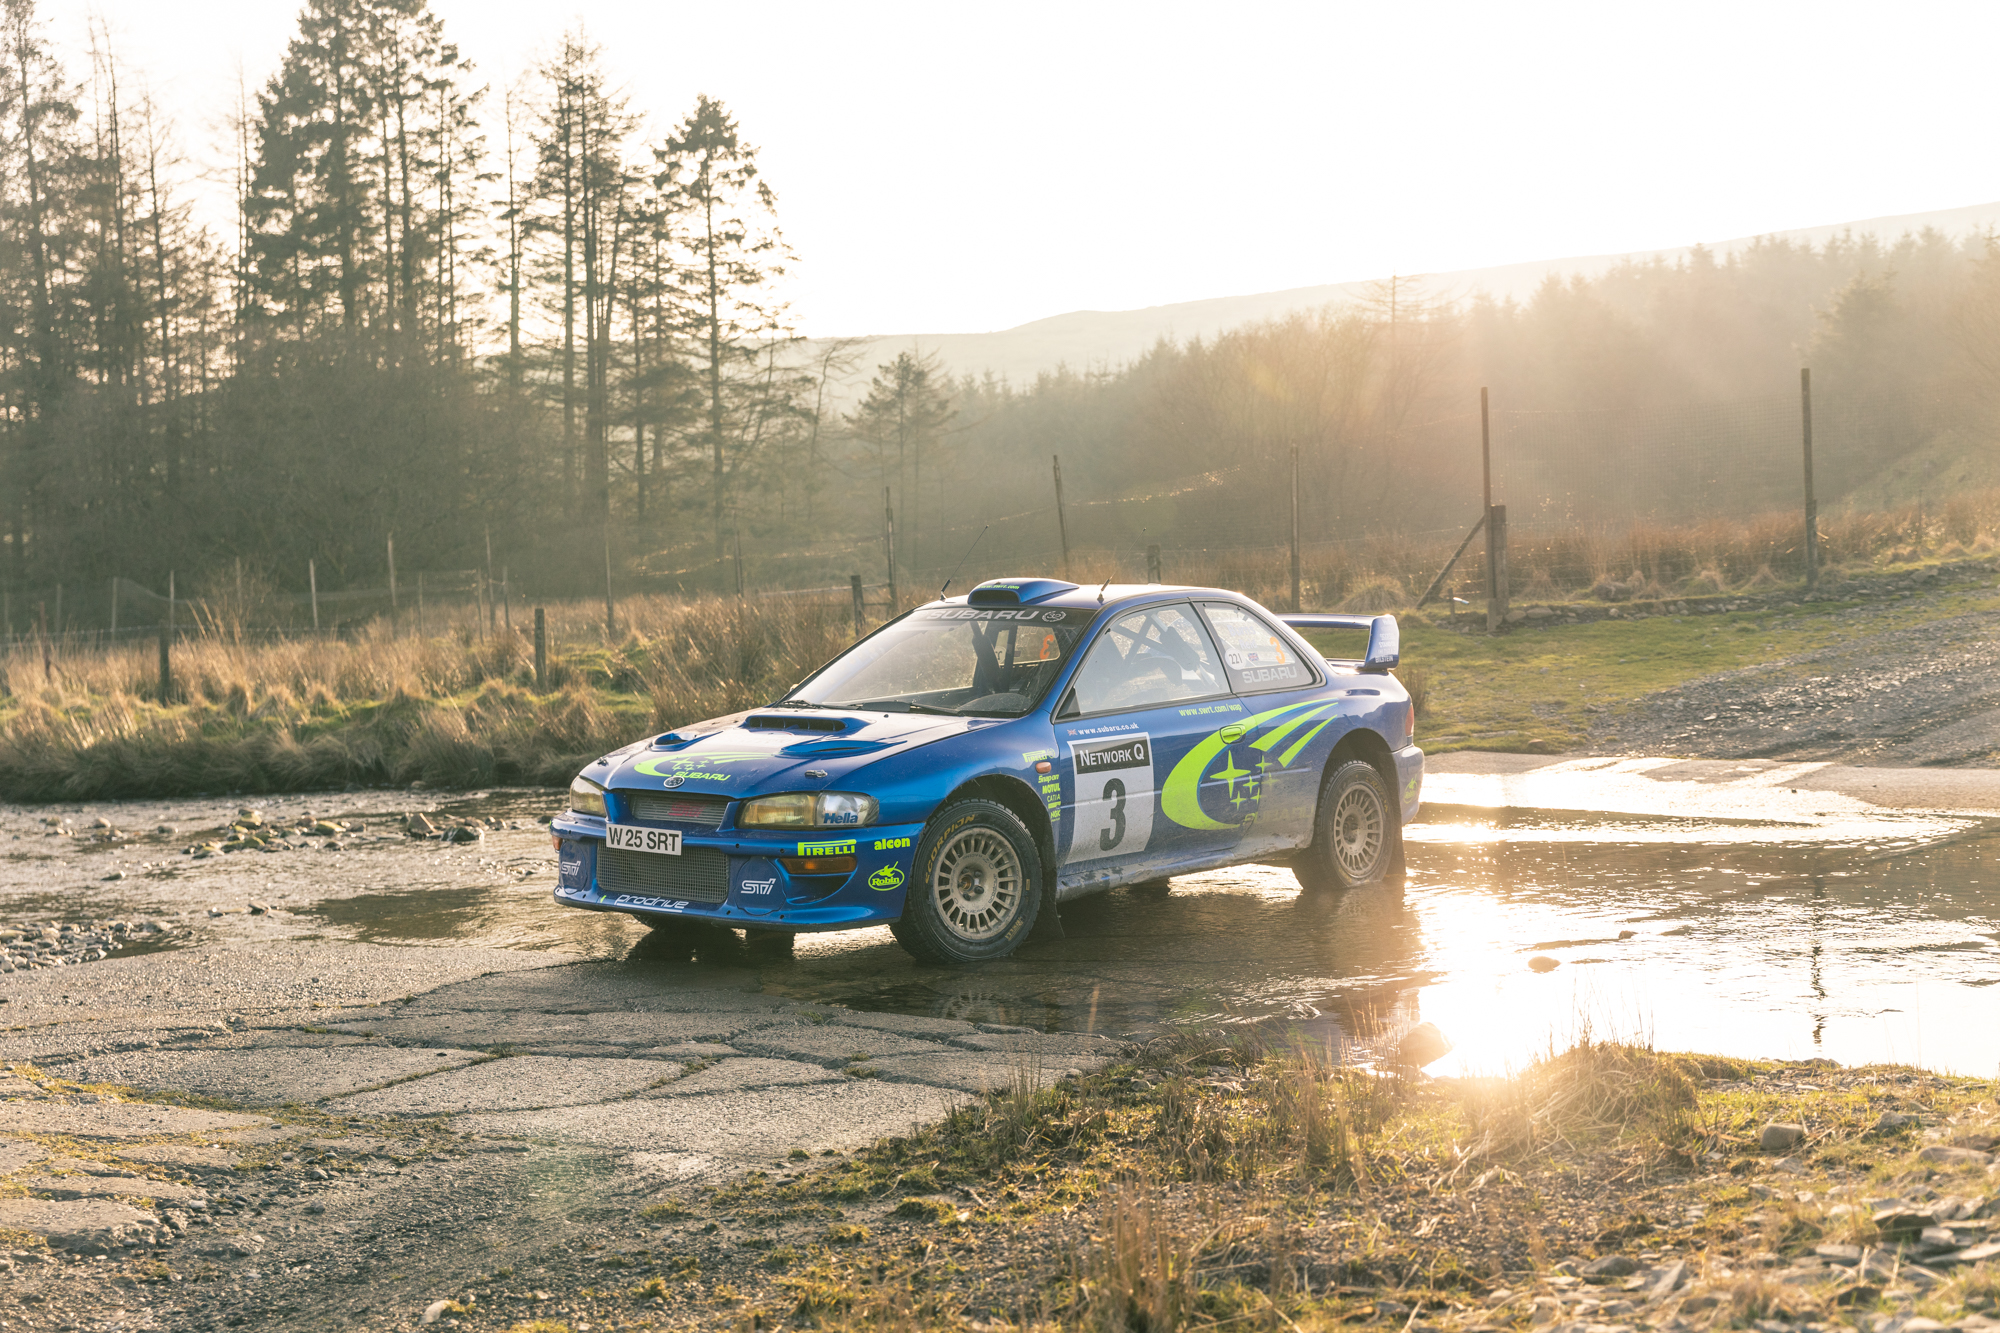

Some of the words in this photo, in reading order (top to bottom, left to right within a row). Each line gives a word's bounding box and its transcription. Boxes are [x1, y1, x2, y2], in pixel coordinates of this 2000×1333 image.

[926, 610, 1040, 620] SUBARU
[1269, 636, 1286, 665] 3
[1228, 652, 1243, 665] 221
[1242, 666, 1297, 684] SUBARU
[1179, 703, 1242, 716] www.swrt.com/wap
[1078, 722, 1139, 735] www.subaru.co.uk
[1079, 748, 1133, 767] NETWORK
[1133, 743, 1145, 760] Q
[673, 771, 731, 782] SUBARU
[1042, 783, 1060, 794] MOTUL
[823, 813, 858, 825] Hella
[1100, 777, 1126, 851] 3
[608, 827, 623, 846] W
[625, 829, 643, 848] 25
[646, 830, 680, 852] SRT
[874, 837, 911, 851] alcon
[797, 839, 857, 856] PIRELLI
[925, 814, 976, 884] SCORPION
[871, 876, 900, 887] Robin
[614, 894, 689, 909] prodrive
